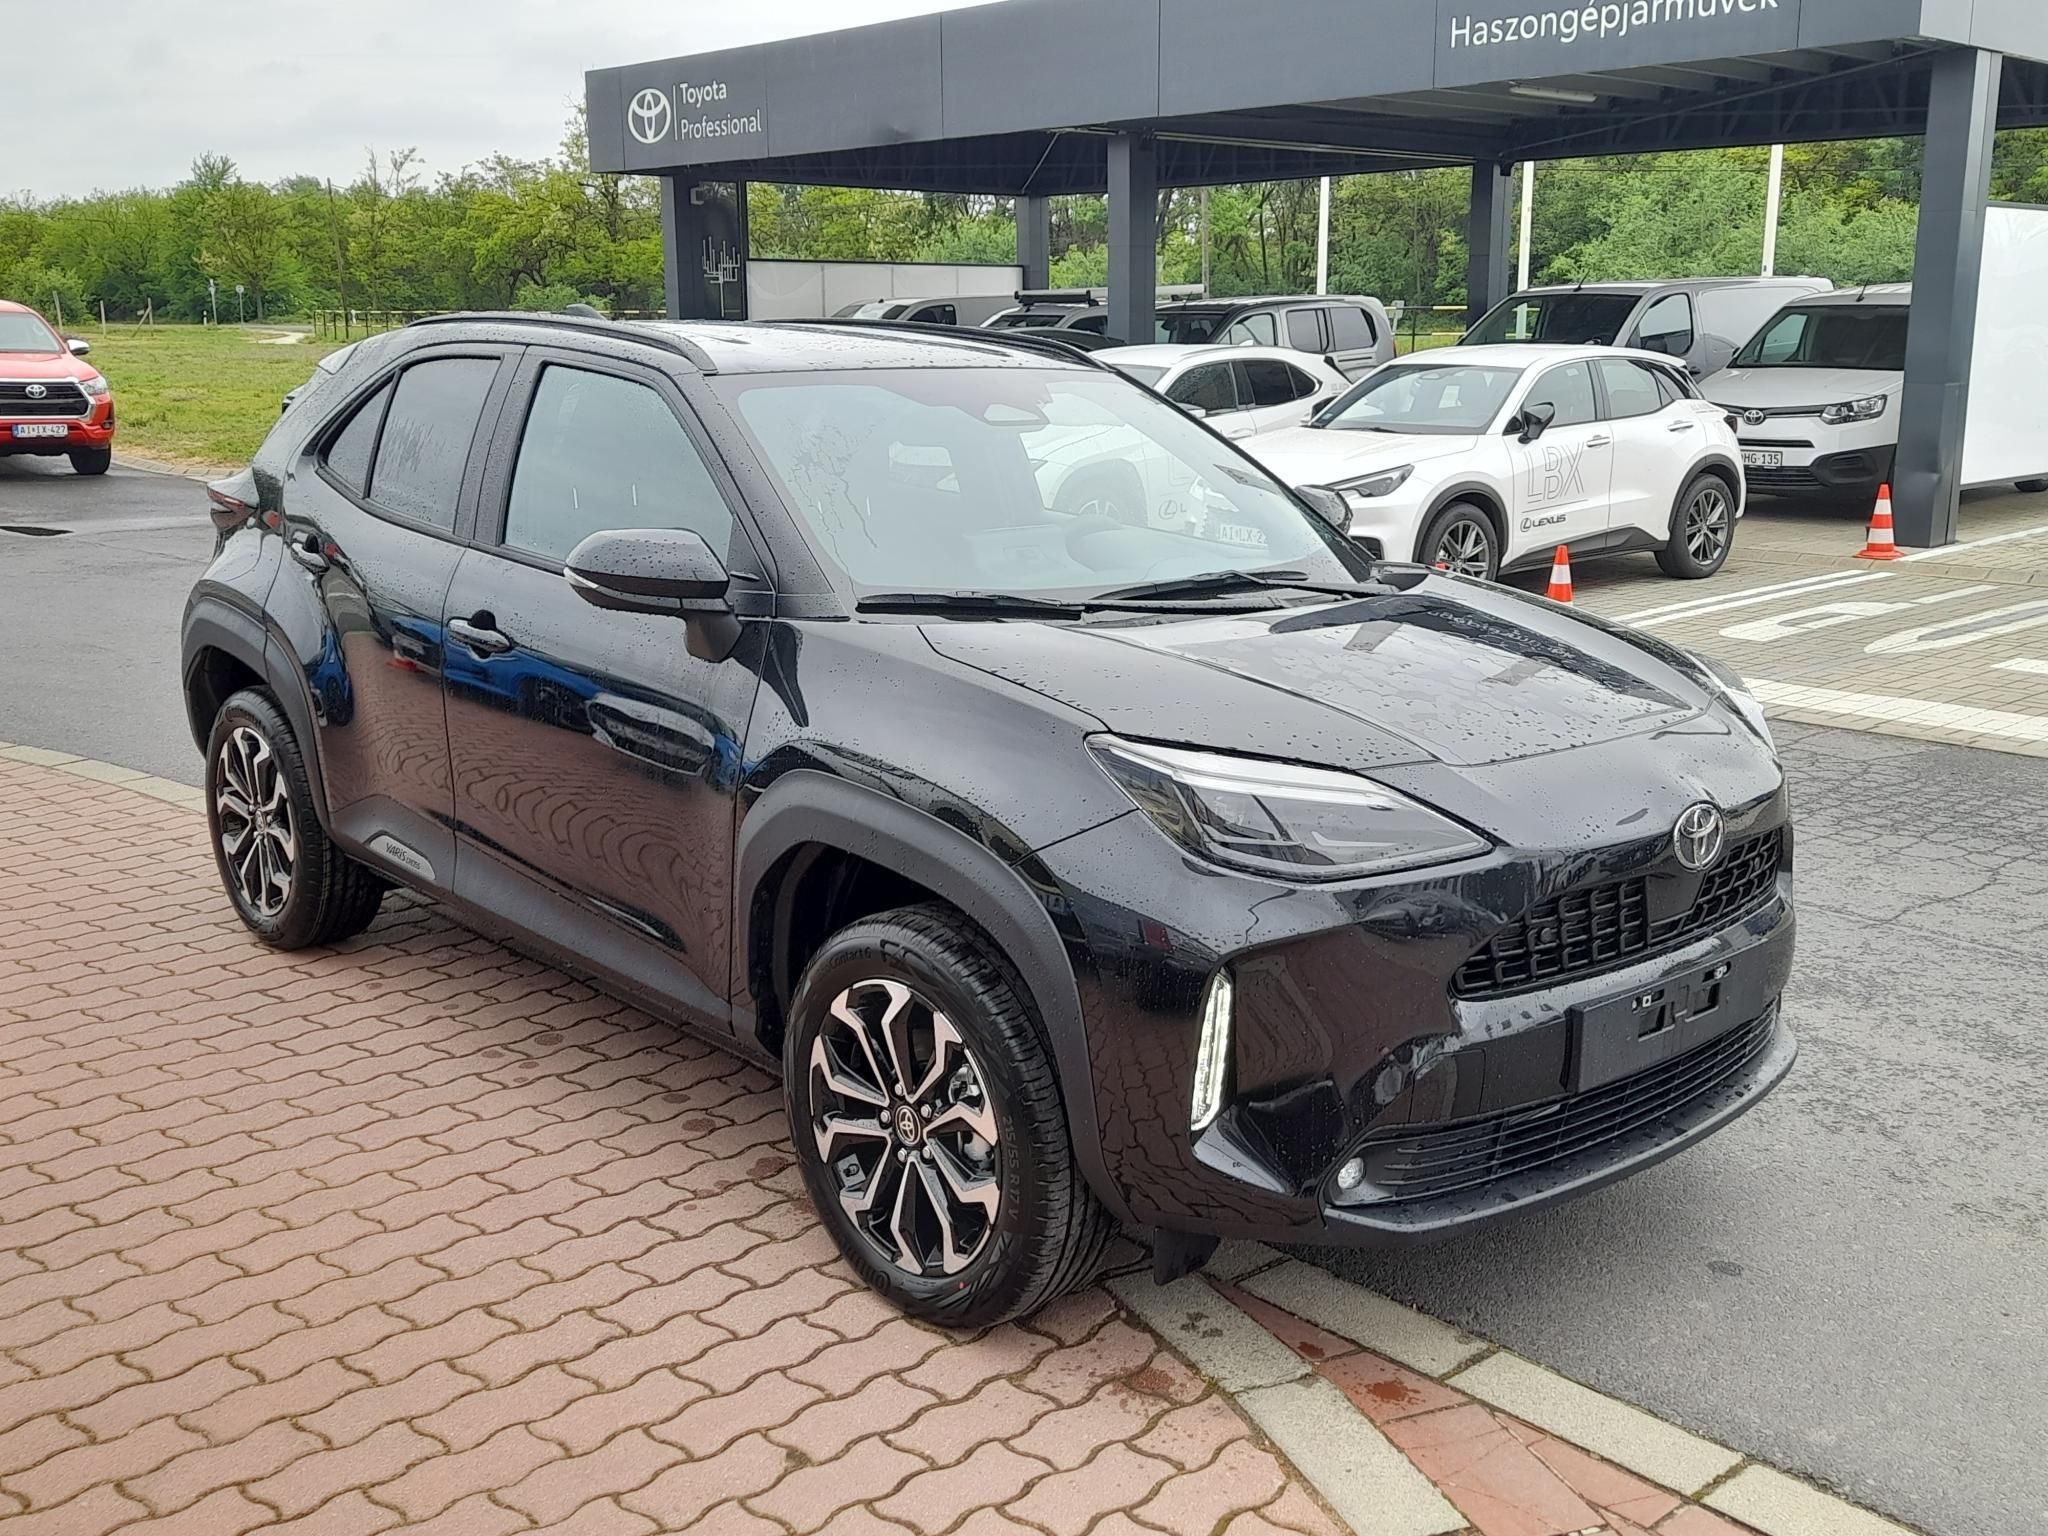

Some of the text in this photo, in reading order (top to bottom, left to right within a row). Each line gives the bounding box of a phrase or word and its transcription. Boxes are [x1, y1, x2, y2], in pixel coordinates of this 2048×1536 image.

[679, 80, 728, 108] Toyota
[680, 108, 762, 141] Professional
[1524, 441, 1585, 503] LBX
[1532, 514, 1567, 528] LEXUS
